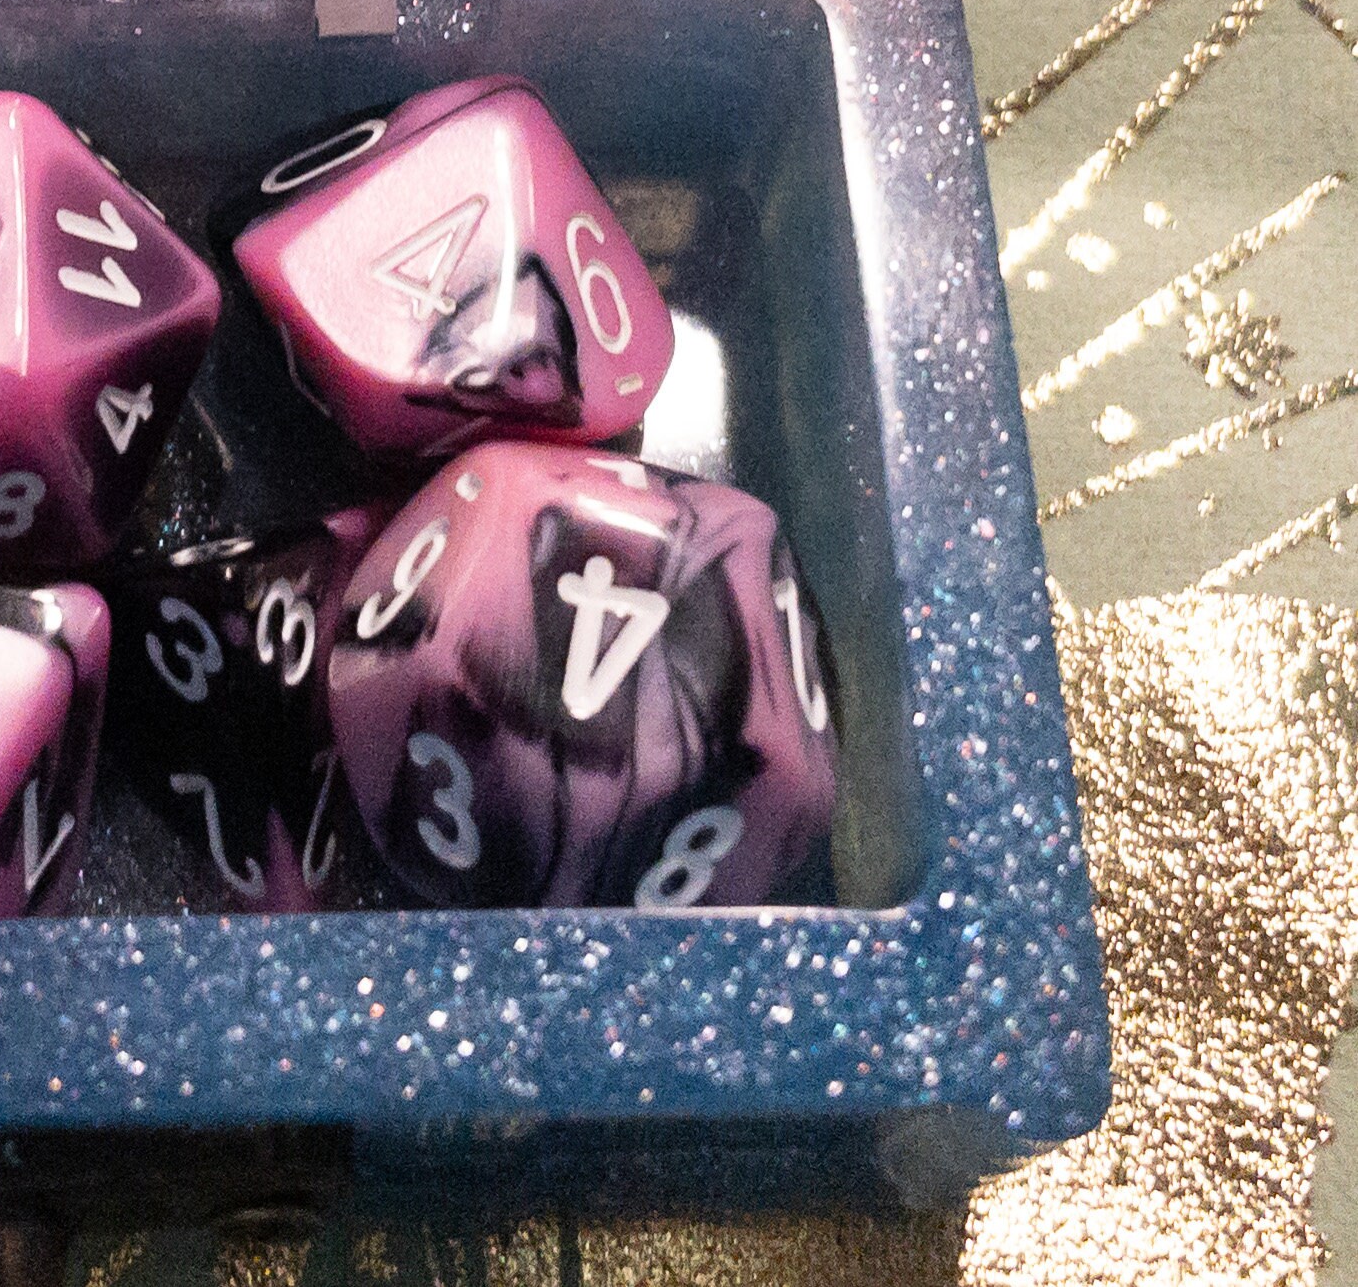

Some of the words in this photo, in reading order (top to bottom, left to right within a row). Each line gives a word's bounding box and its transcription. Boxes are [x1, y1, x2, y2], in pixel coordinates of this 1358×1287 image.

[260, 118, 388, 194] 0
[56, 199, 142, 309] 11
[369, 193, 490, 320] 4
[565, 212, 633, 356] 6
[95, 382, 155, 455] 4
[145, 596, 224, 703] 3
[255, 577, 316, 686] 3
[556, 554, 671, 722] 4
[169, 772, 266, 899] 2
[408, 731, 482, 870] 3
[634, 803, 744, 909] 8
